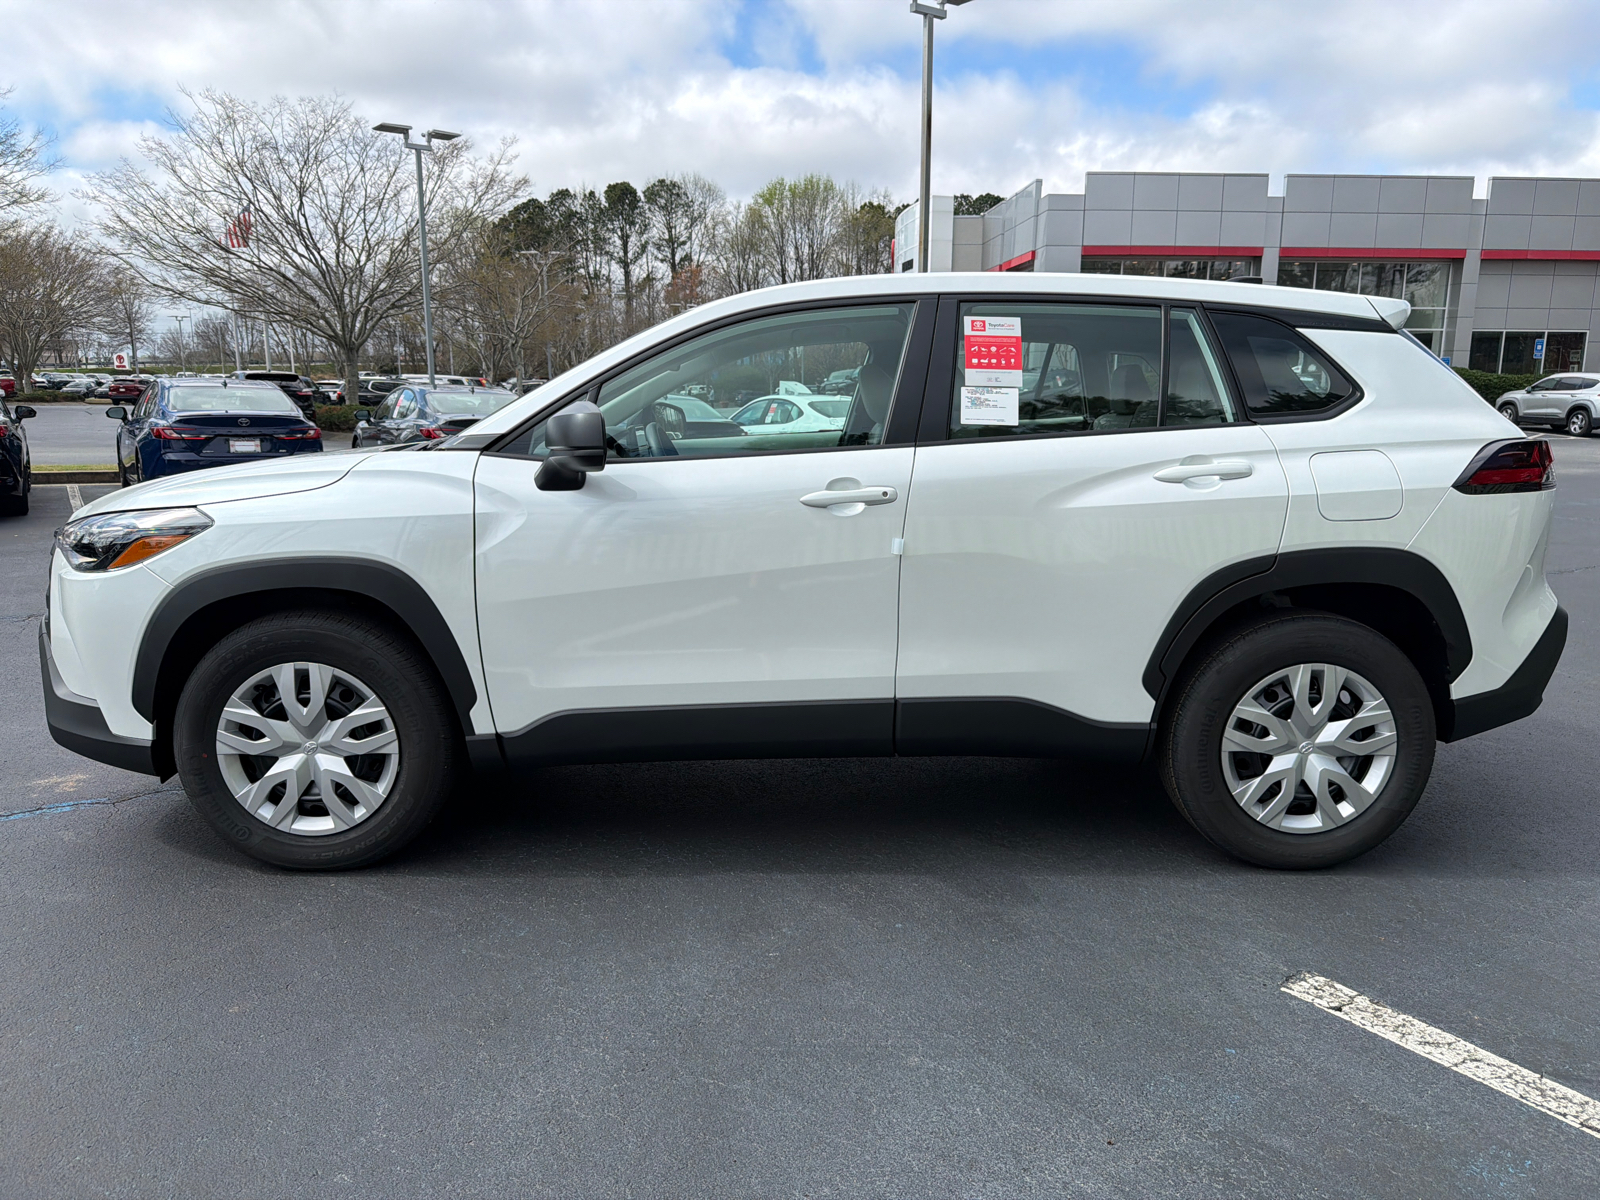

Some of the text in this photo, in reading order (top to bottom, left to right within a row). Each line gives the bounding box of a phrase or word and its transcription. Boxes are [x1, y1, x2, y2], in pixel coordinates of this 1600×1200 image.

[1196, 706, 1218, 796] Continental
[1403, 705, 1424, 792] Continental
[188, 764, 254, 845] Continental
